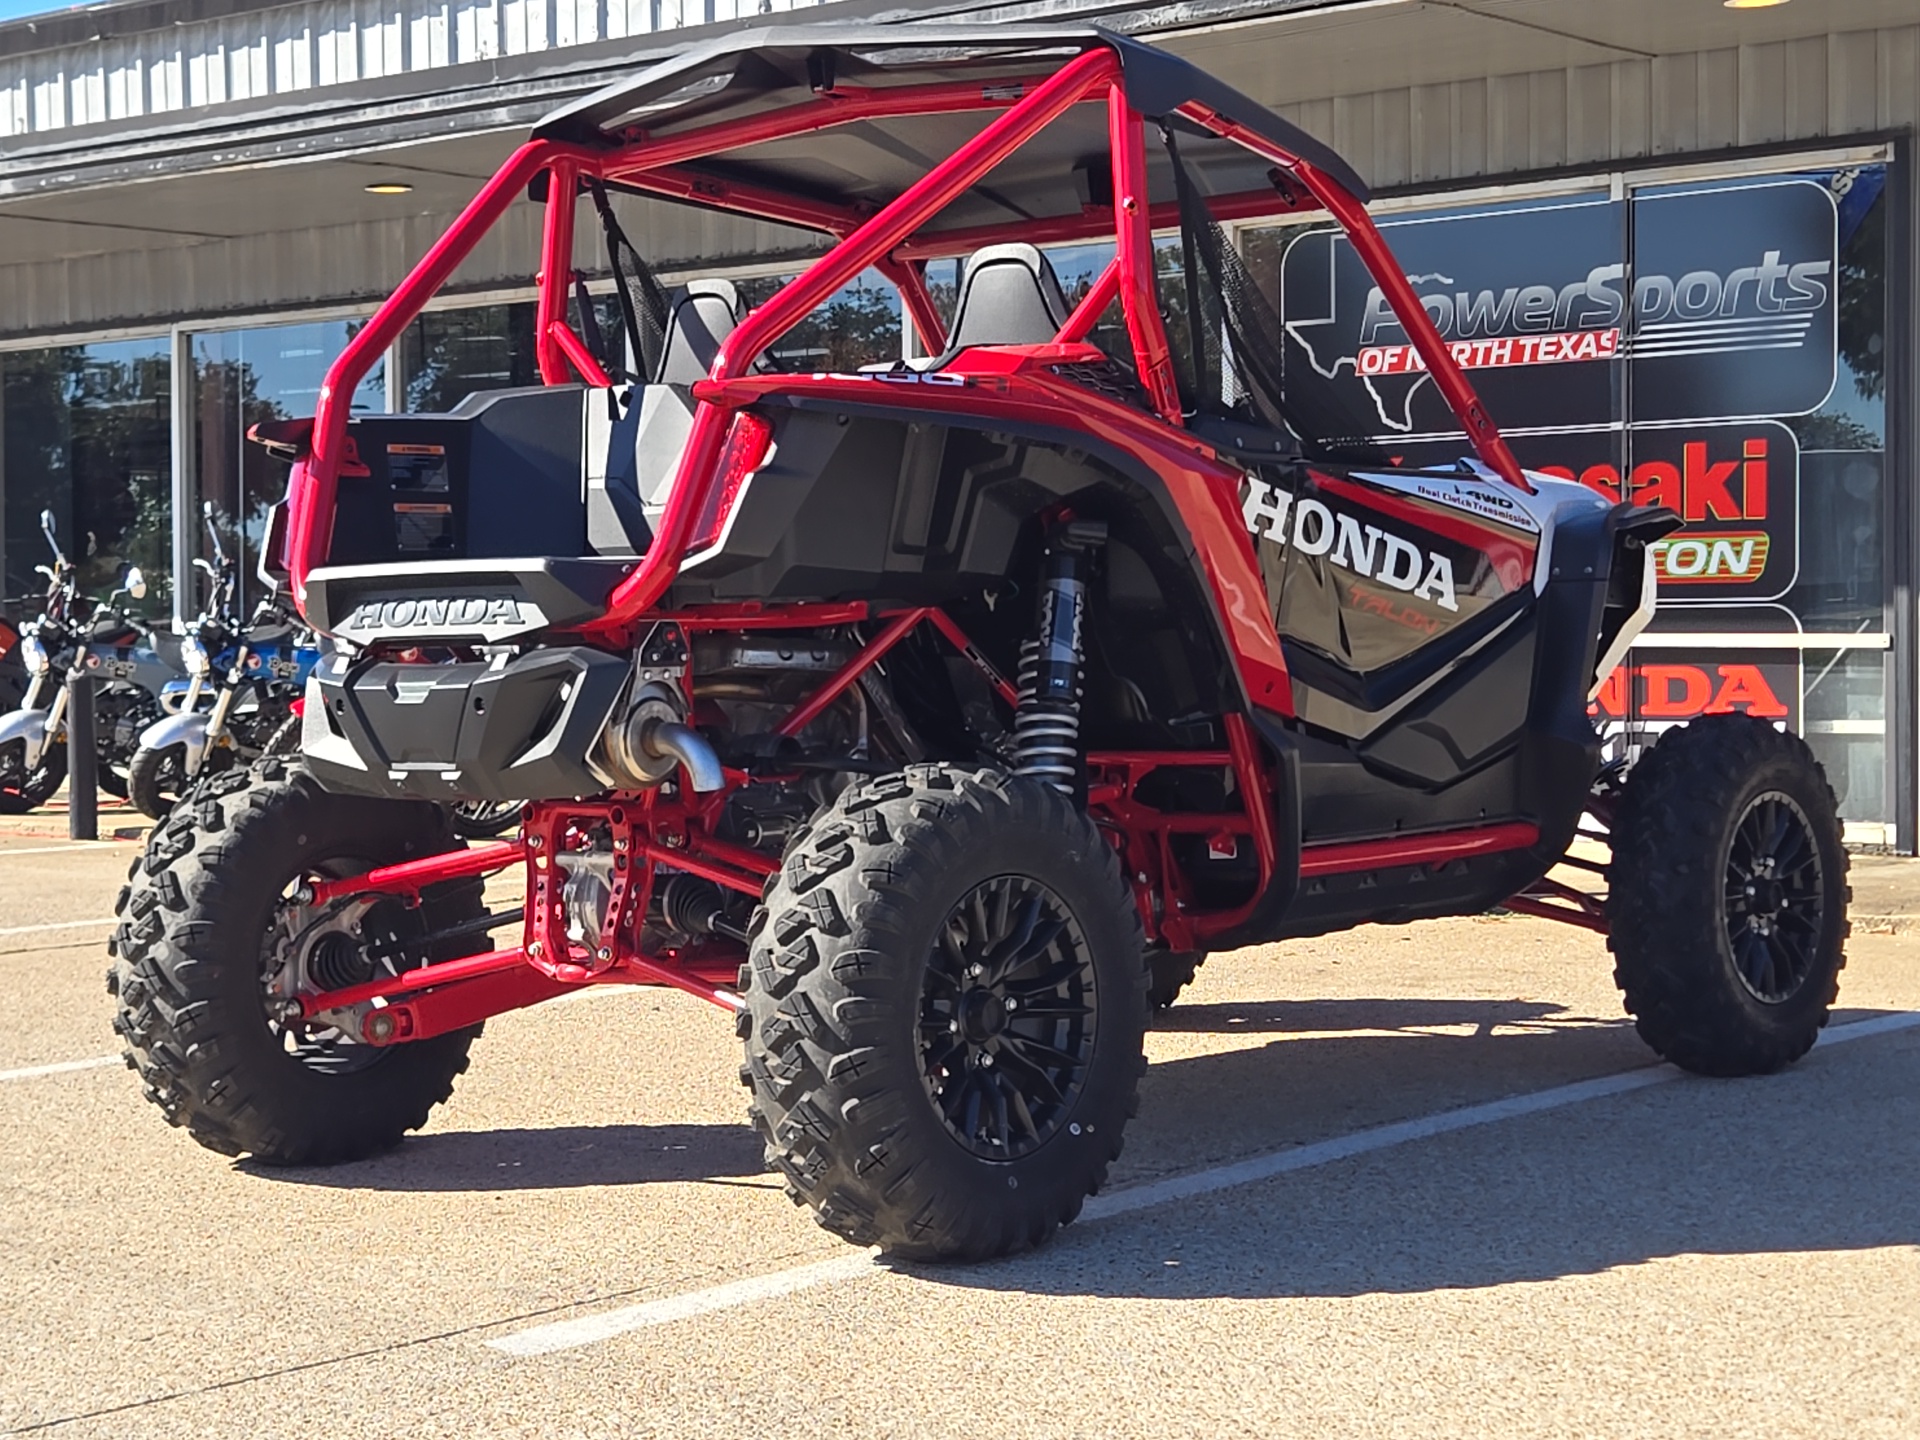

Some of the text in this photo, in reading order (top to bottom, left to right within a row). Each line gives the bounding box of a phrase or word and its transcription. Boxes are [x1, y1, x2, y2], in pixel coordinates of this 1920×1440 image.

[1360, 250, 1831, 344] PowerSports
[1361, 332, 1615, 373] OF NRTH TEXAS
[1473, 501, 1532, 527] Transmission
[1242, 477, 1459, 612] HONDA
[350, 594, 527, 631] HONDA
[1350, 587, 1441, 634] TALON
